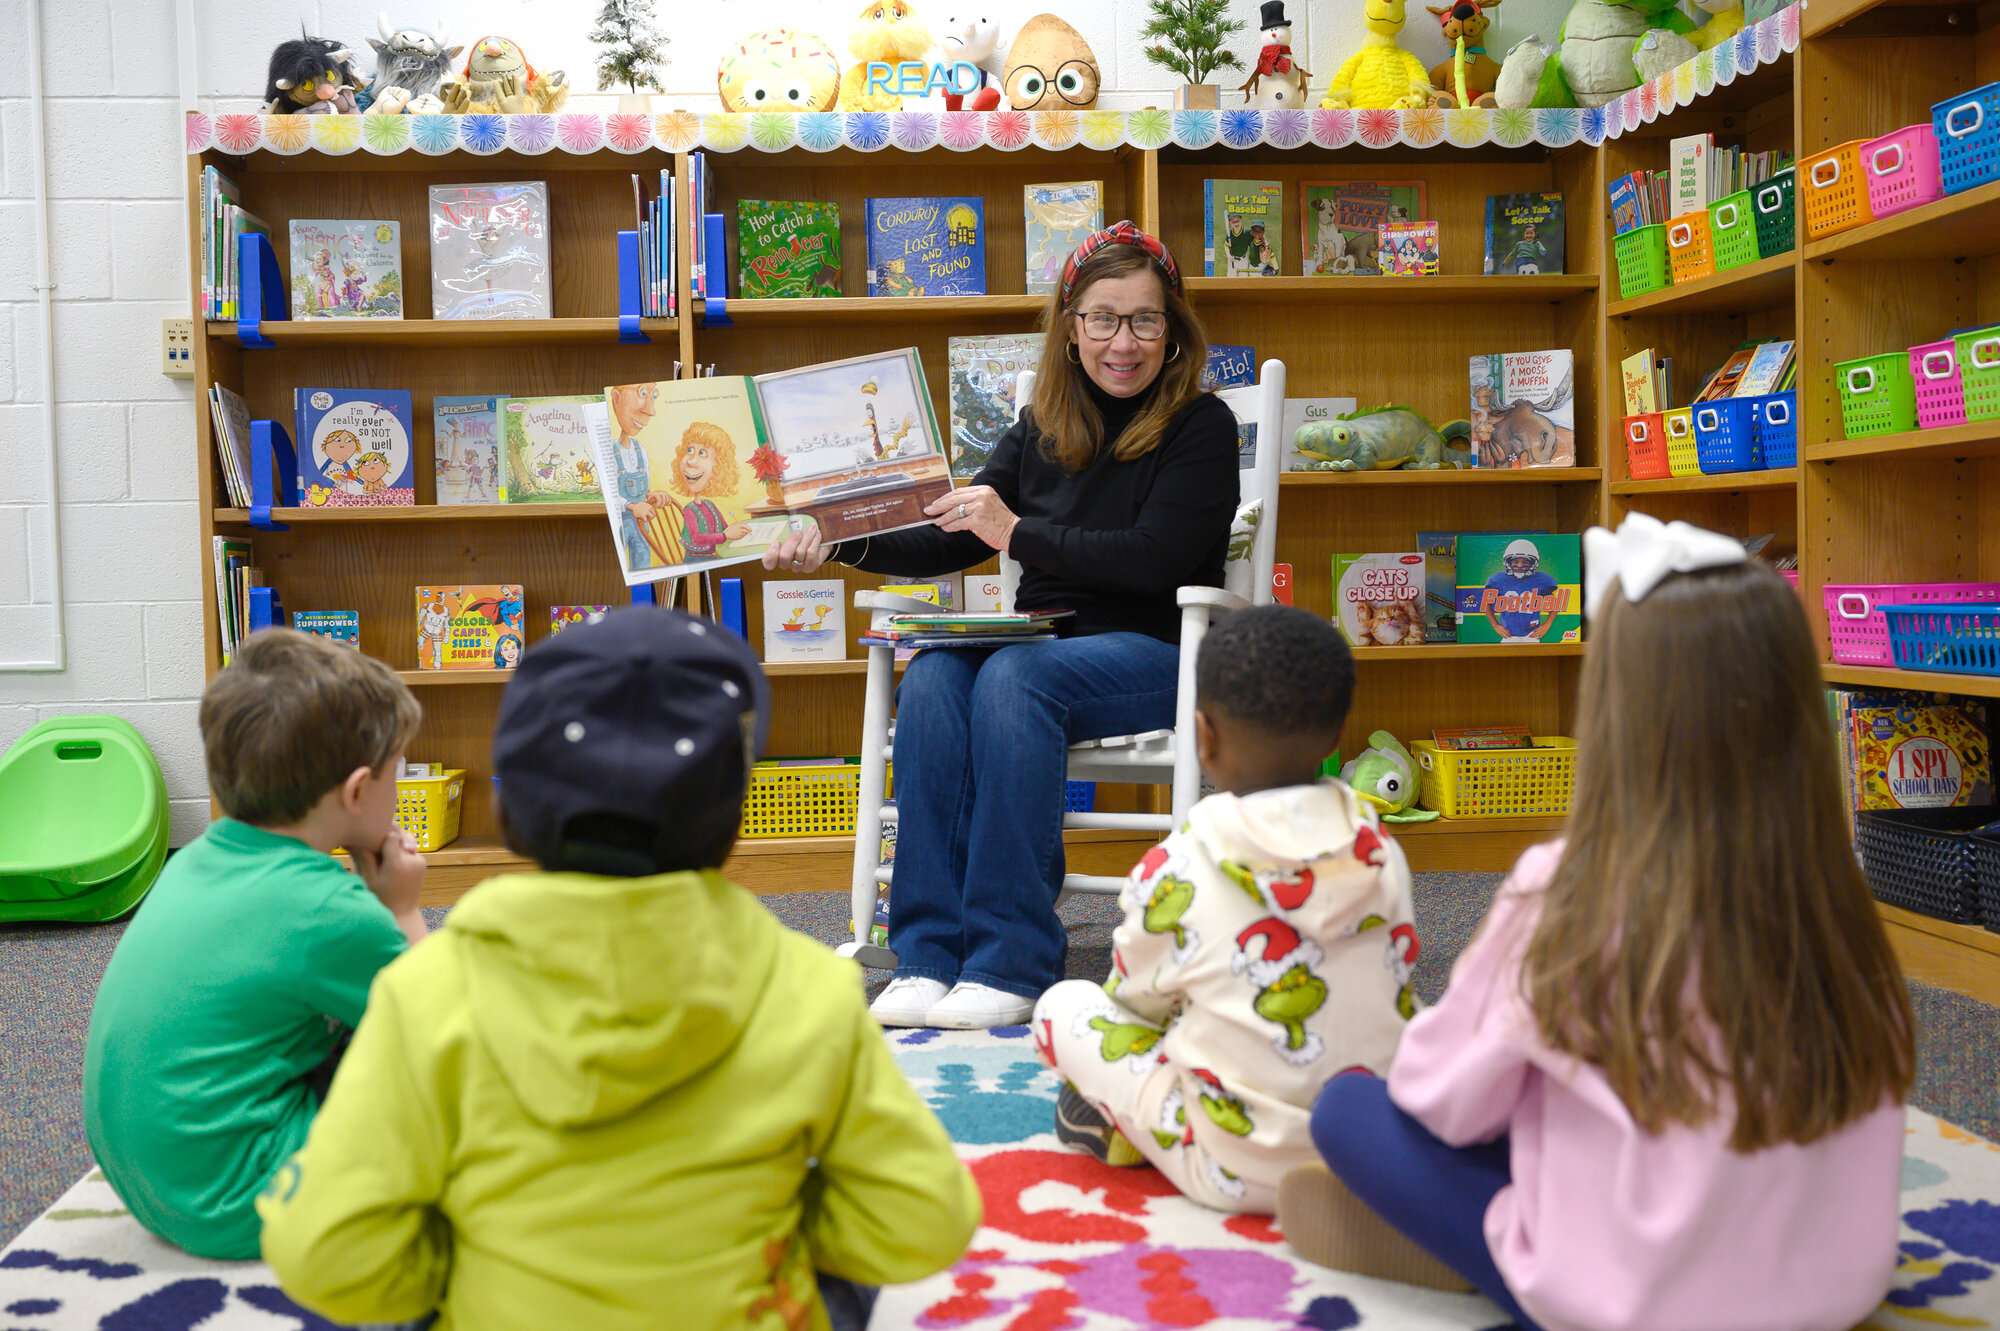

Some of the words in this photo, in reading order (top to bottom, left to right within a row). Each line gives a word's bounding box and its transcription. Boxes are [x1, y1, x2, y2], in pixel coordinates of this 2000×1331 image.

[867, 61, 979, 98] READ
[1683, 156, 1694, 166] Good
[1681, 178, 1696, 187] Amelia
[1225, 194, 1249, 204] Let's
[1251, 195, 1270, 204] Talk
[1680, 188, 1696, 198] Bedelia
[1229, 205, 1267, 214] Baseball
[1339, 200, 1386, 215] PUPPY
[1505, 207, 1529, 216] Let's
[1532, 205, 1551, 214] Talk
[748, 211, 775, 233] How
[877, 206, 939, 232] CORDUROY
[1339, 213, 1381, 229] LOVE
[1511, 216, 1544, 225] Soccer
[758, 235, 771, 247] to
[771, 212, 803, 238] Catch
[806, 213, 814, 225] a
[1403, 230, 1436, 238] POWER
[905, 233, 938, 254] LOST
[921, 248, 942, 263] AND
[928, 256, 971, 280] FOUND
[1220, 352, 1250, 380] Ho!
[1505, 357, 1514, 367] IF
[1515, 356, 1530, 365] YOU
[1532, 355, 1552, 365] GIVE
[1510, 368, 1516, 377] A
[1519, 366, 1547, 376] MOOSE
[1509, 378, 1515, 387] A
[1518, 376, 1549, 386] MUFFIN
[1305, 405, 1328, 417] Gus
[333, 416, 360, 426] really
[362, 418, 384, 426] ever
[525, 408, 571, 427] Angelina
[371, 429, 390, 437] NOT
[464, 421, 496, 438] NANC
[548, 425, 564, 434] and
[372, 439, 391, 450] well
[1362, 568, 1408, 586] CATS
[1346, 587, 1394, 602] CLOSE
[1396, 586, 1420, 601] UP
[1480, 588, 1571, 612] Football
[448, 617, 496, 626] COLORS,
[453, 628, 491, 637] CAPES,
[452, 638, 482, 648] SIZES
[485, 639, 491, 647] &
[451, 649, 493, 659] SHAPES
[1897, 750, 1905, 778] I
[1912, 748, 1950, 778] SPY
[1893, 778, 1931, 795] SCHOOL
[1933, 777, 1958, 794] DAYS
